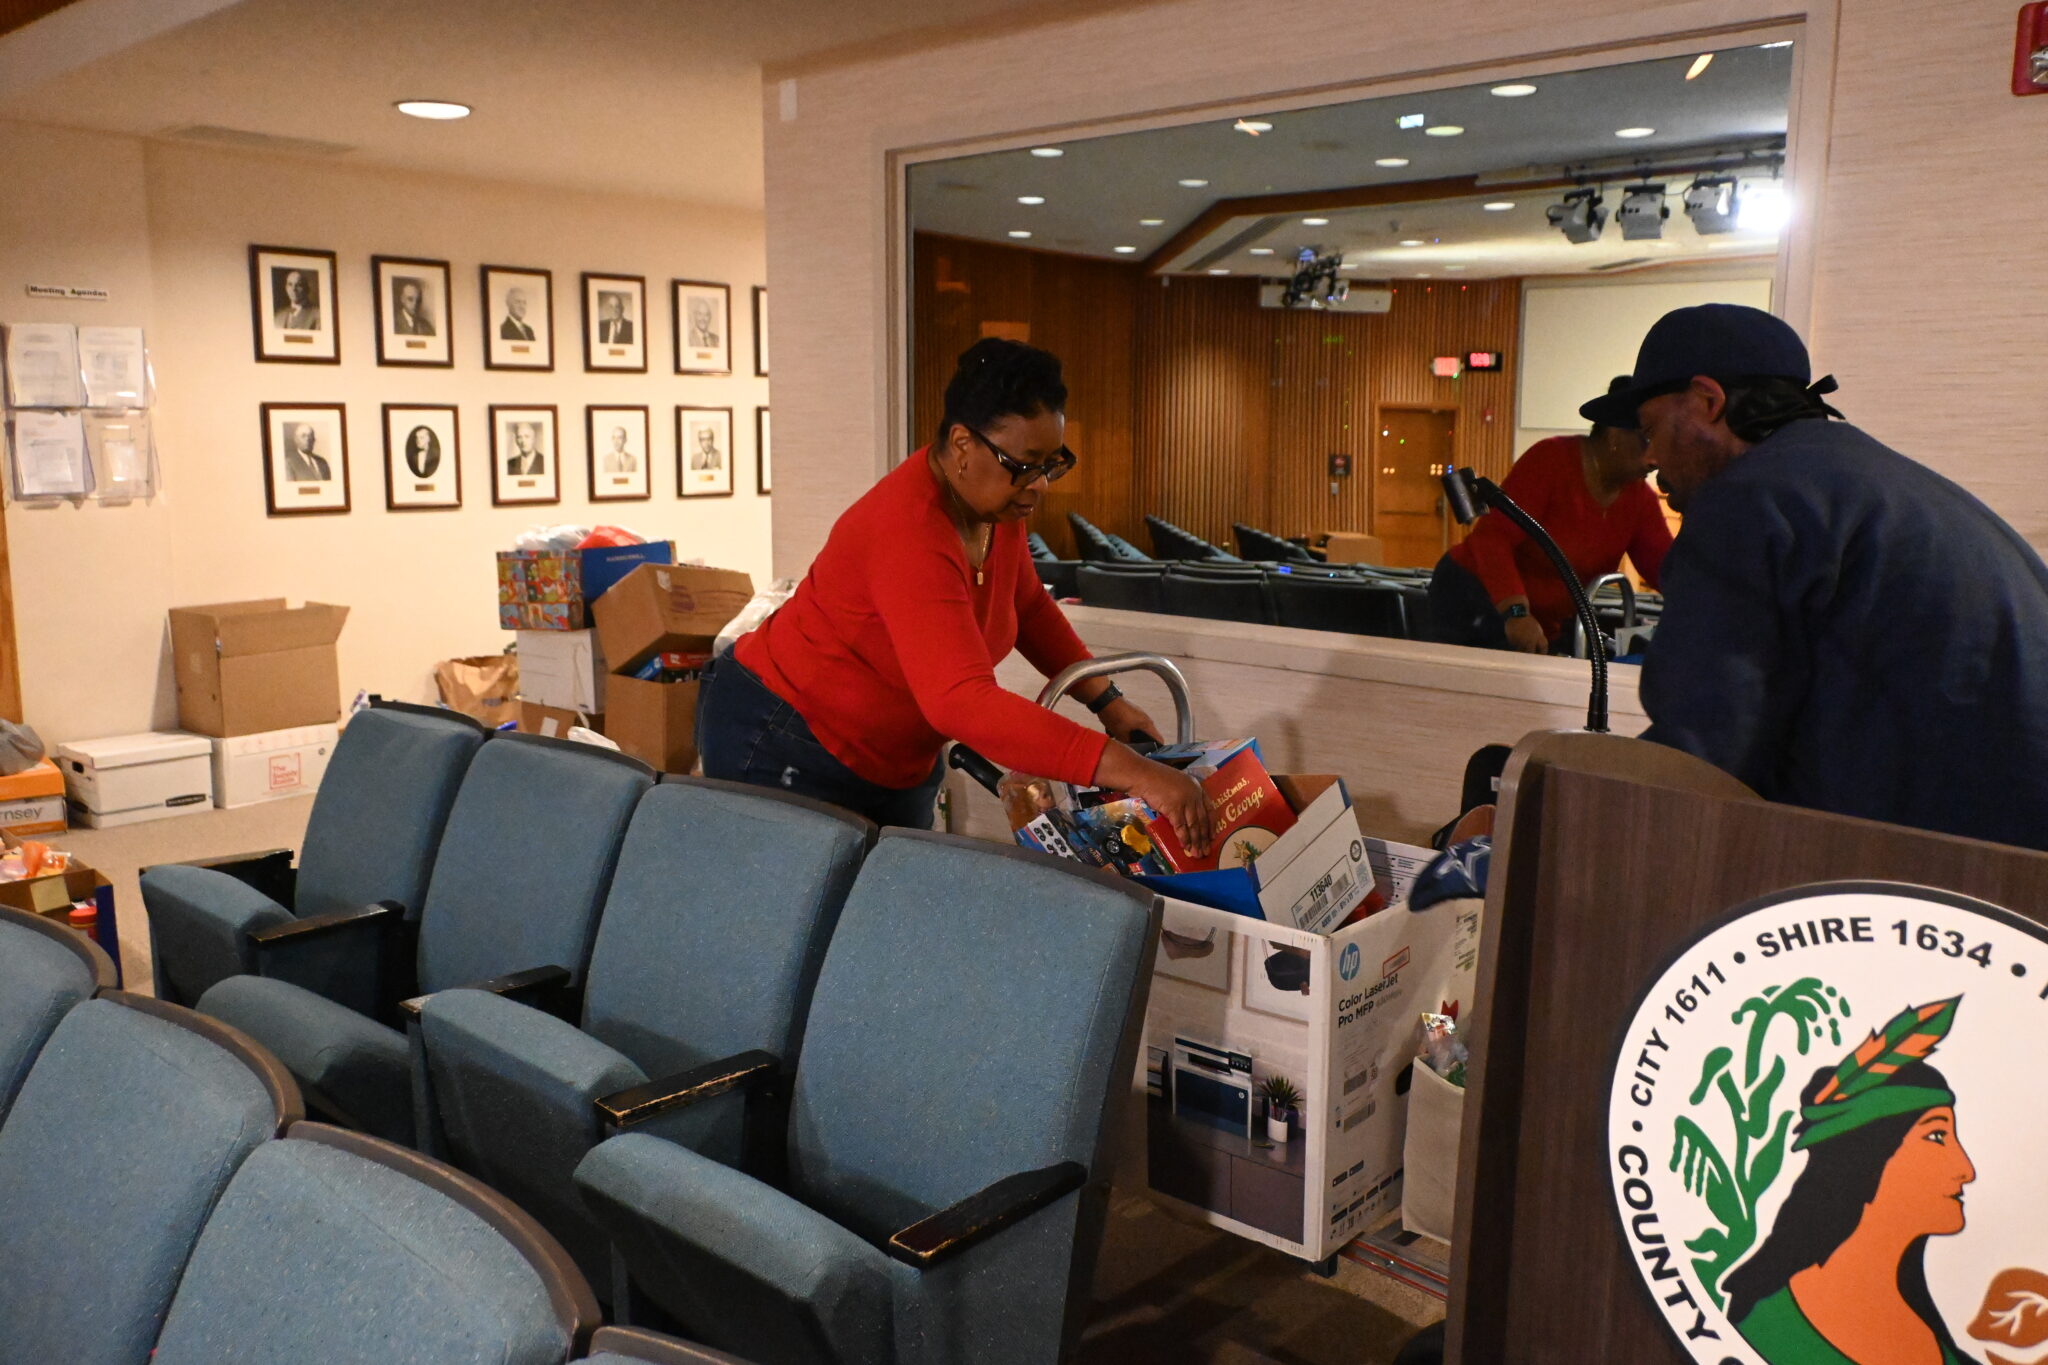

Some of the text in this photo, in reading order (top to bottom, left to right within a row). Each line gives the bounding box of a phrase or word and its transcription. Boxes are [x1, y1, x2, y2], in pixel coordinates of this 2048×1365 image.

[30, 285, 108, 297] Meeting Agendas
[1213, 777, 1250, 809] hristmas,
[1225, 786, 1264, 822] George
[1310, 874, 1333, 901] 113640
[1341, 945, 1360, 981] hp
[1338, 992, 1363, 1012] Color
[1364, 973, 1398, 1000] LaserJet
[1338, 1000, 1374, 1029] Pro MFP
[1631, 917, 1993, 1107] CITY 1611 SHIRE 1634
[1618, 1144, 1722, 1341] COUNTY
